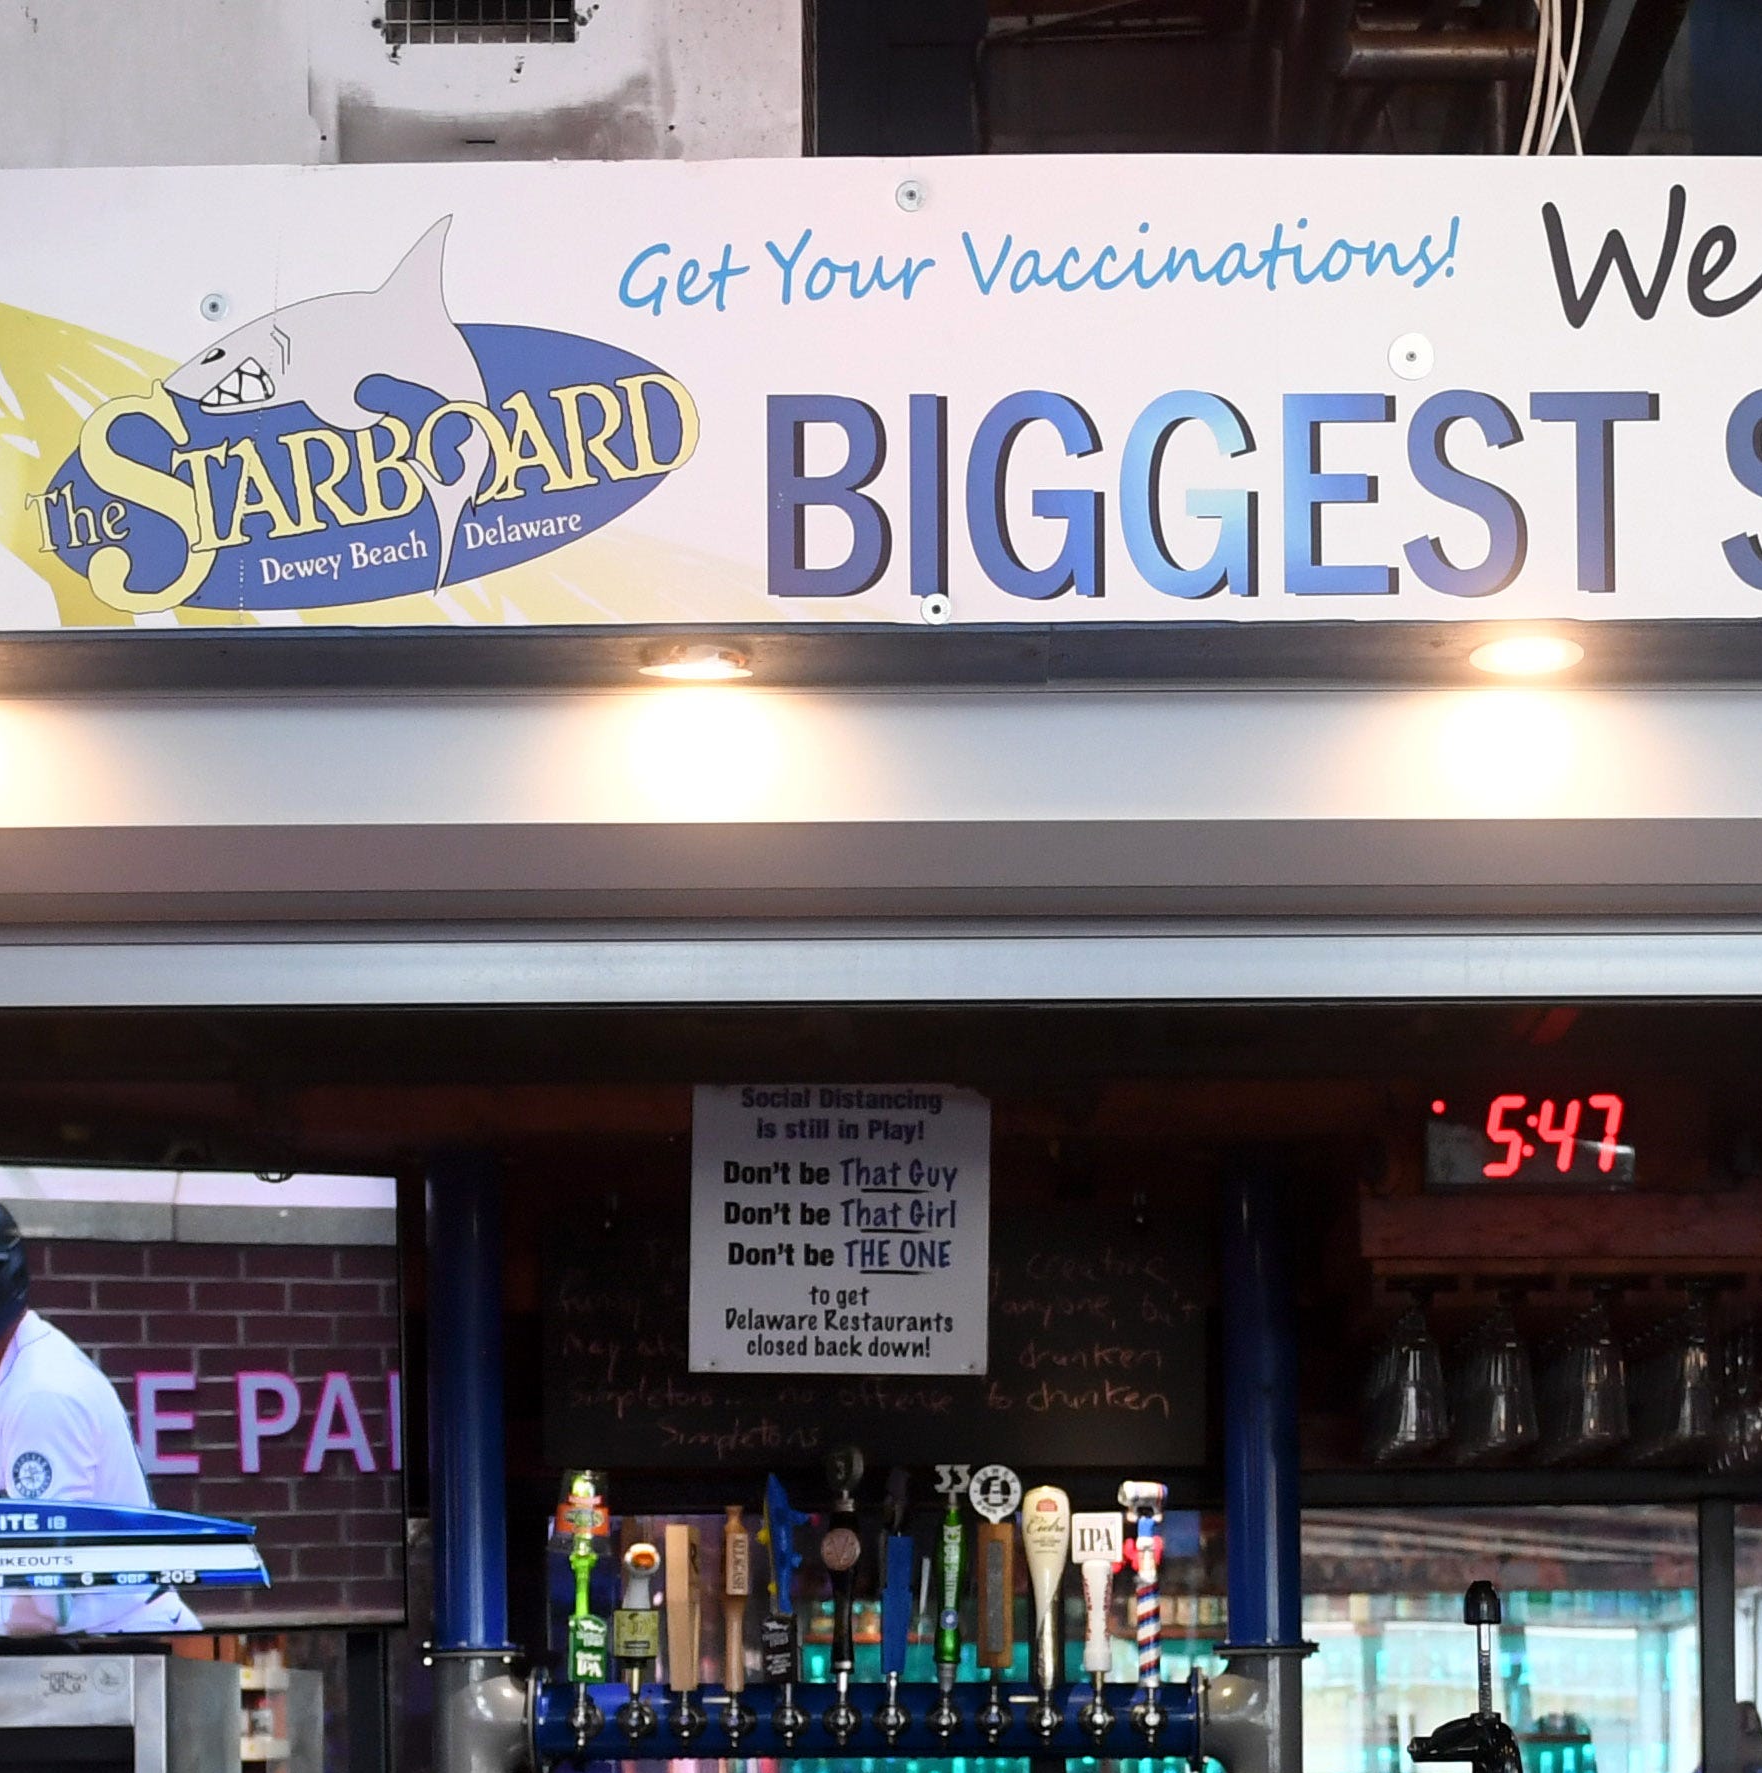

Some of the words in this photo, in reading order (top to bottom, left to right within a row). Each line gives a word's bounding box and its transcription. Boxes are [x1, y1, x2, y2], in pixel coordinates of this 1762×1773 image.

[618, 243, 747, 316] Get
[764, 230, 934, 303] Your
[962, 218, 1461, 300] Vaccinations!
[767, 389, 1660, 601] BIGGEST
[24, 491, 131, 552] The
[261, 548, 342, 591] Dewey
[348, 531, 429, 571] Beach
[464, 510, 583, 554] Delaware
[741, 1087, 810, 1109] Social
[819, 1088, 943, 1114] Distancing
[757, 1118, 776, 1139] is
[785, 1118, 829, 1139] still
[838, 1118, 859, 1139] in
[868, 1119, 924, 1144] Play!
[1483, 1095, 1623, 1177] 5:47
[723, 1161, 790, 1184] Don't
[799, 1161, 830, 1184] be
[840, 1158, 901, 1186] That
[909, 1158, 958, 1192] Guy
[724, 1201, 791, 1224] Don't
[800, 1202, 830, 1225] be
[841, 1199, 901, 1227] That
[909, 1200, 956, 1228] Girl
[728, 1242, 794, 1265] Don't
[804, 1243, 834, 1266] be
[844, 1239, 890, 1268] THE
[900, 1240, 952, 1268] ONE
[809, 1286, 830, 1305] to
[836, 1286, 870, 1309] get
[725, 1308, 817, 1331] Delaware
[824, 1309, 954, 1333] Restaurants
[747, 1335, 807, 1356] closed
[815, 1336, 862, 1357] back
[868, 1336, 931, 1357] down!
[1078, 1528, 1113, 1552] IPA
[34, 1576, 60, 1588] RBI
[81, 1573, 93, 1586] 6
[116, 1573, 147, 1586] OBP
[155, 1570, 196, 1585] .205
